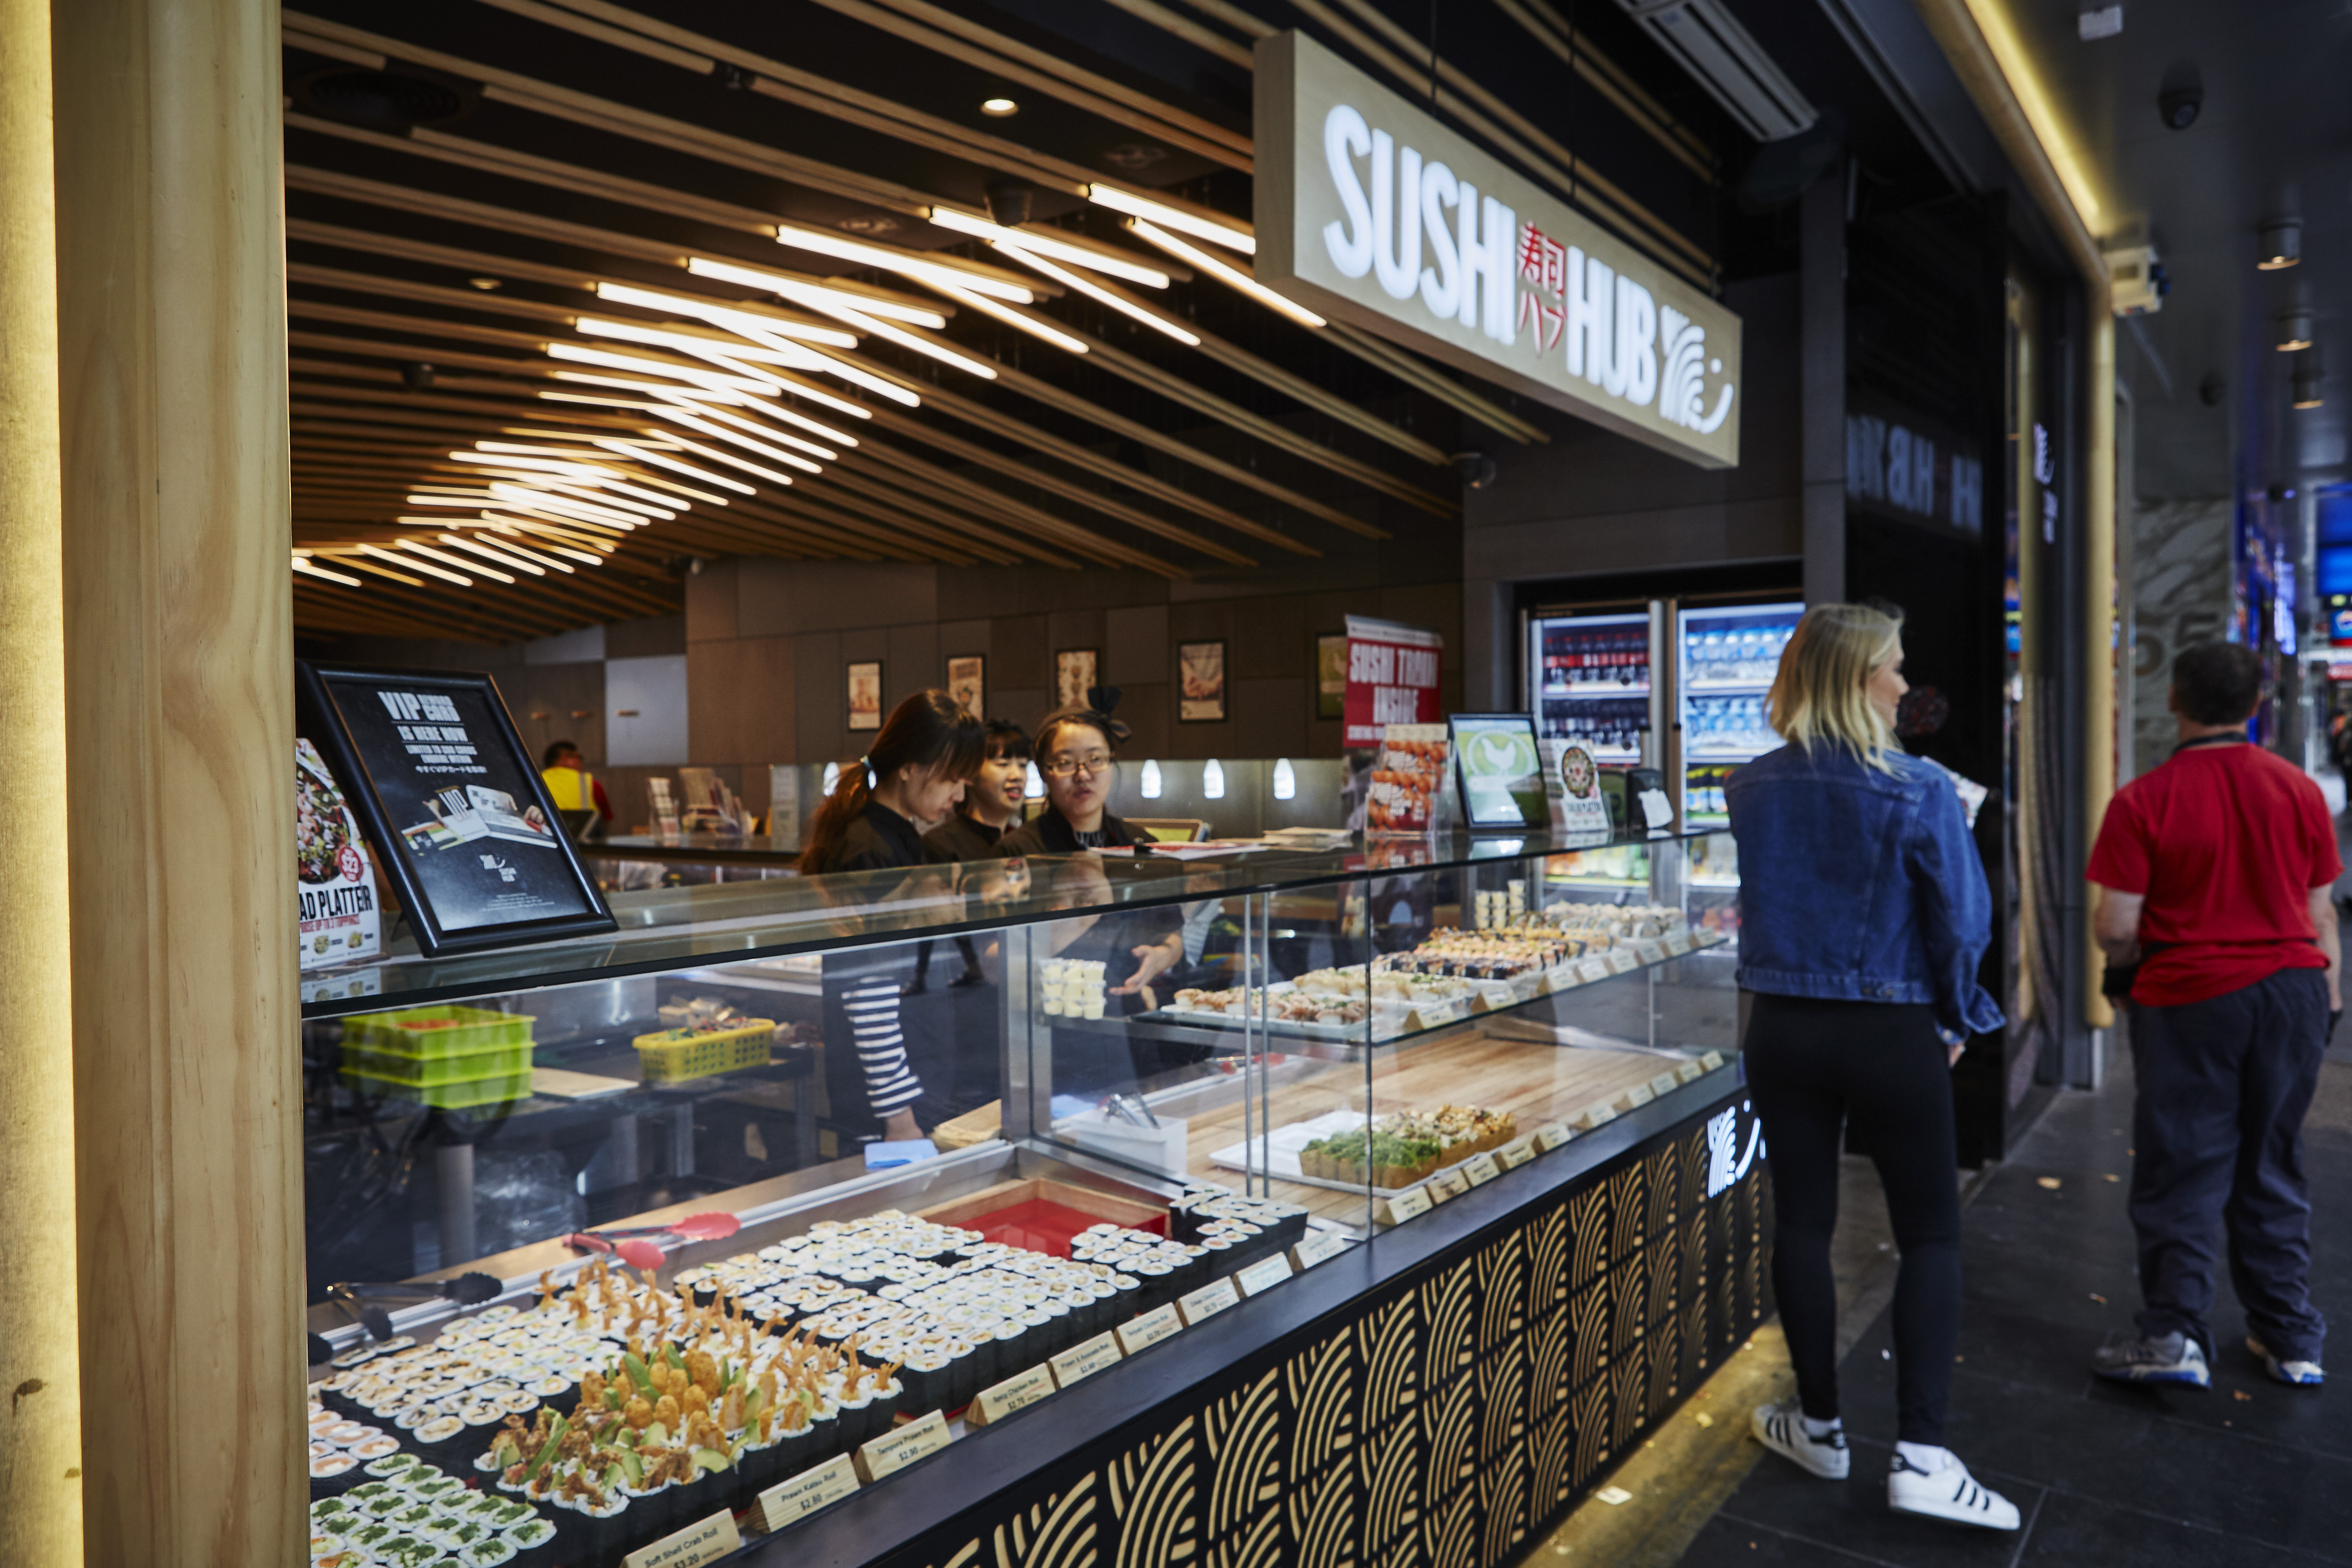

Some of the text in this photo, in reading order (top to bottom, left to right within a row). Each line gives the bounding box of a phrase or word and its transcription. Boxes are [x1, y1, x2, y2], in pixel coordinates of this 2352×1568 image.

[1323, 104, 1658, 407] SUSHI HUB
[1516, 220, 1566, 300] 寿司
[1350, 642, 1394, 684] SUSHI
[377, 691, 421, 720] VIP
[397, 726, 468, 742] IS HERE NOW
[438, 788, 469, 820] VIP
[341, 853, 359, 873] $23
[299, 885, 372, 920] AD PLATTER
[923, 1424, 934, 1433] Roll
[781, 1488, 803, 1502] Prawn
[823, 1470, 837, 1482] Roll
[645, 1527, 719, 1568] Soft Shell Crab Roll
[674, 1553, 700, 1568] $3.20
